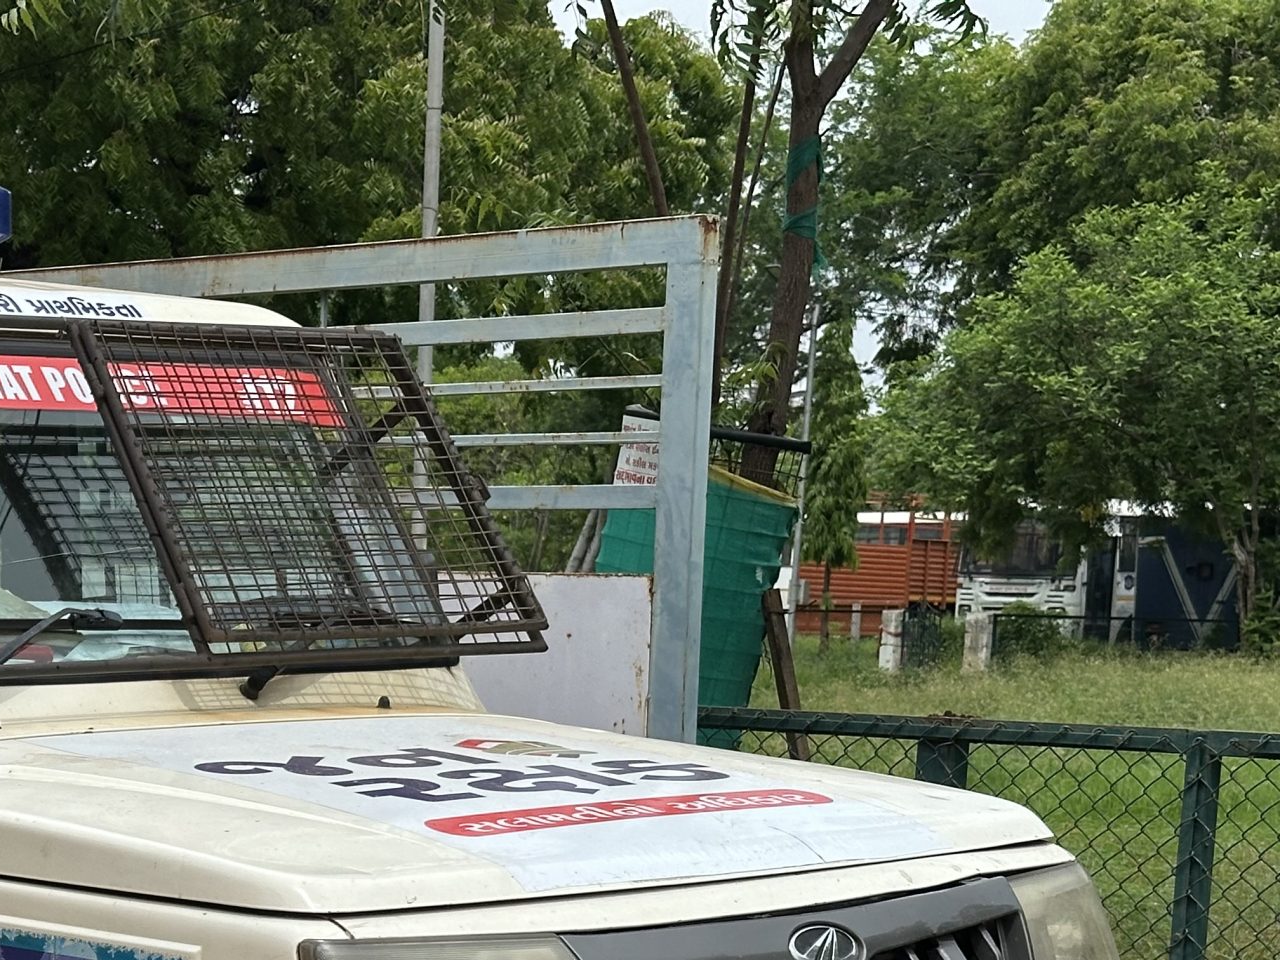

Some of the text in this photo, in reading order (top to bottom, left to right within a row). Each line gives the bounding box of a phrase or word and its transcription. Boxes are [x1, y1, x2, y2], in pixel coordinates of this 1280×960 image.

[26, 296, 143, 318] પ્રાથમિકતા
[194, 748, 500, 777] જન
[328, 758, 731, 802] રક્ષક
[459, 794, 815, 832] સલામતીનો અધિકાર
